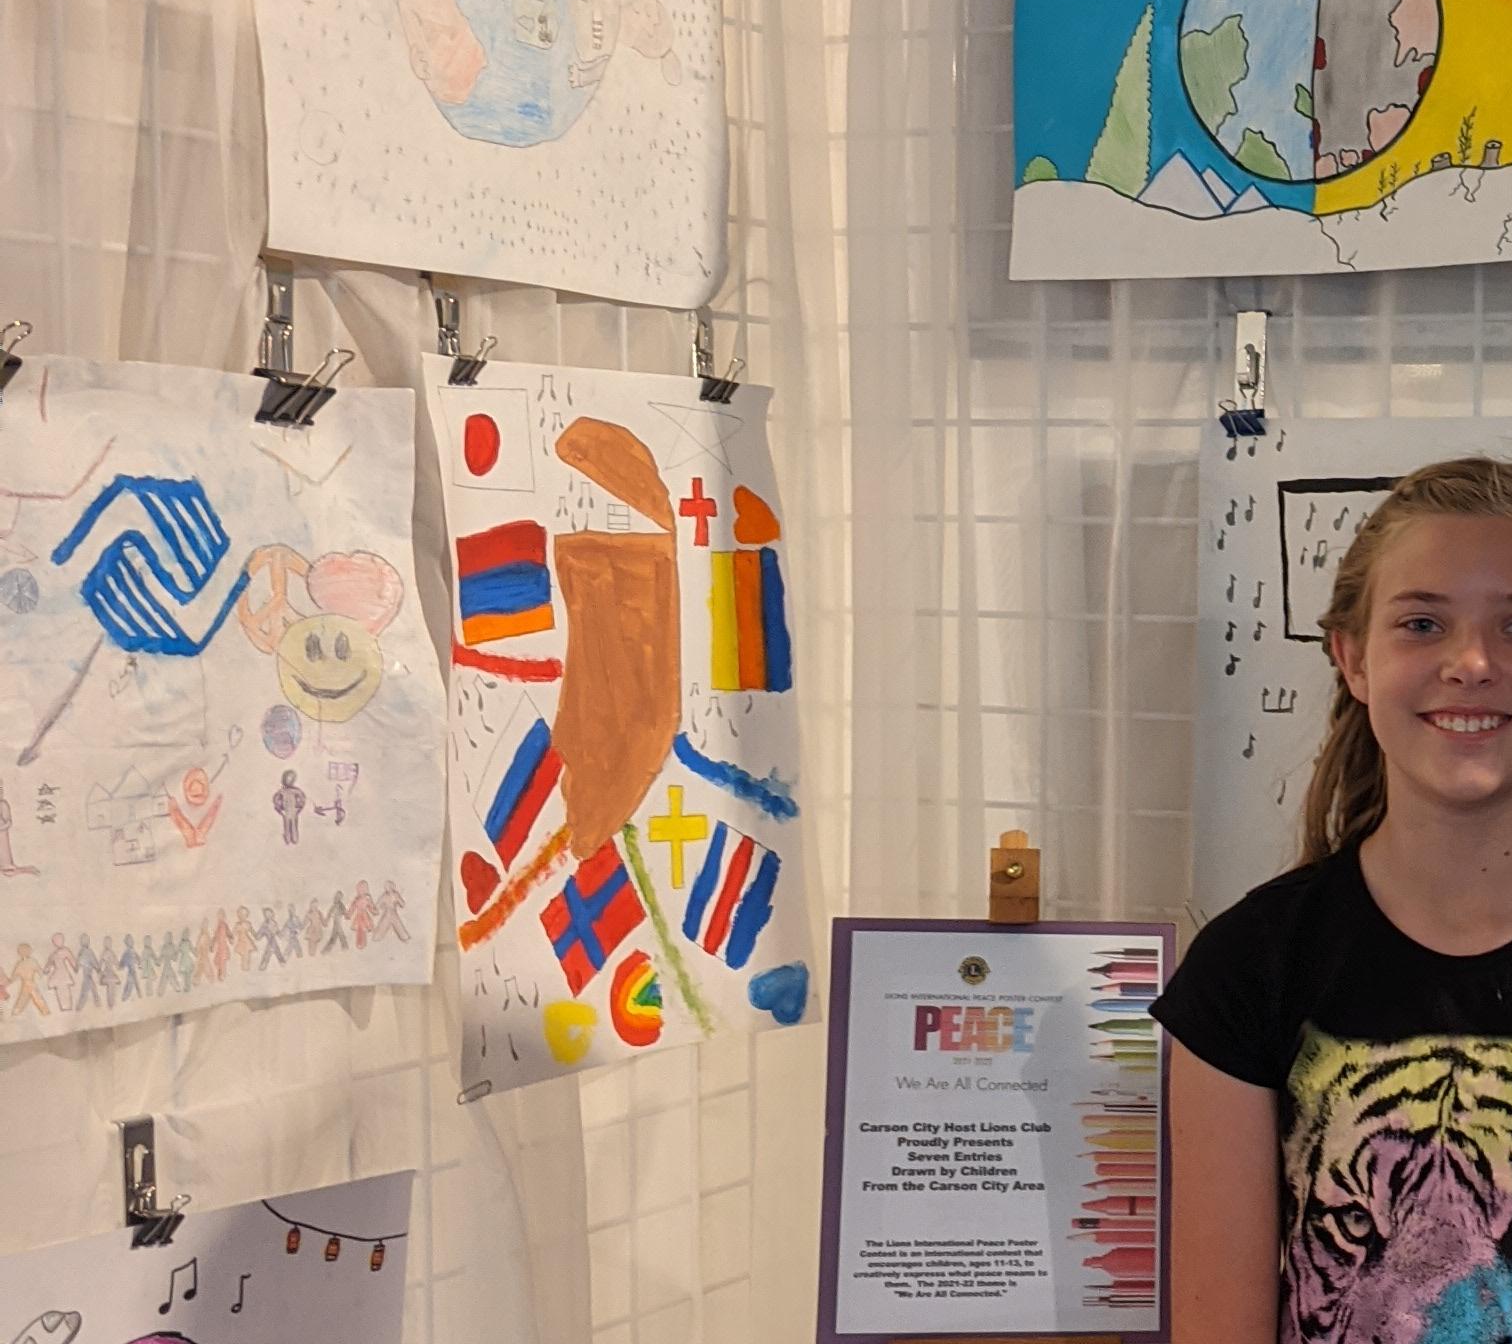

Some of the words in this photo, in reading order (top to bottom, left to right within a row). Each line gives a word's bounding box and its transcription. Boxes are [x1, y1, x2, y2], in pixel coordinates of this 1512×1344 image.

[913, 1005, 1034, 1053] PEACE
[896, 1076, 921, 1090] We
[926, 1077, 949, 1090] Are
[954, 1077, 971, 1090] All
[976, 1077, 1048, 1091] Connected
[859, 1122, 909, 1133] Carson
[912, 1122, 940, 1134] City
[944, 1122, 976, 1133] Host
[980, 1122, 1017, 1133] Lions
[1020, 1122, 1051, 1133] Club
[897, 1137, 950, 1149] Proudly
[953, 1137, 1014, 1147] Presents
[907, 1152, 950, 1162] Seven
[954, 1152, 1003, 1162] Entries
[891, 1166, 936, 1176] Drawn
[940, 1166, 957, 1178] by
[960, 1166, 1018, 1176] Children
[862, 1181, 898, 1191] From
[902, 1181, 925, 1191] the
[929, 1181, 977, 1191] Carson
[981, 1181, 1009, 1193] City
[1012, 1181, 1045, 1191] Area
[914, 1239, 974, 1247] International
[976, 1239, 1005, 1247] Peace
[1008, 1239, 1038, 1247] Poster
[859, 1250, 897, 1258] Contest
[1024, 1249, 1043, 1257] that
[867, 1261, 923, 1269] encourages
[853, 1271, 901, 1279] creatively
[917, 1280, 935, 1288] The
